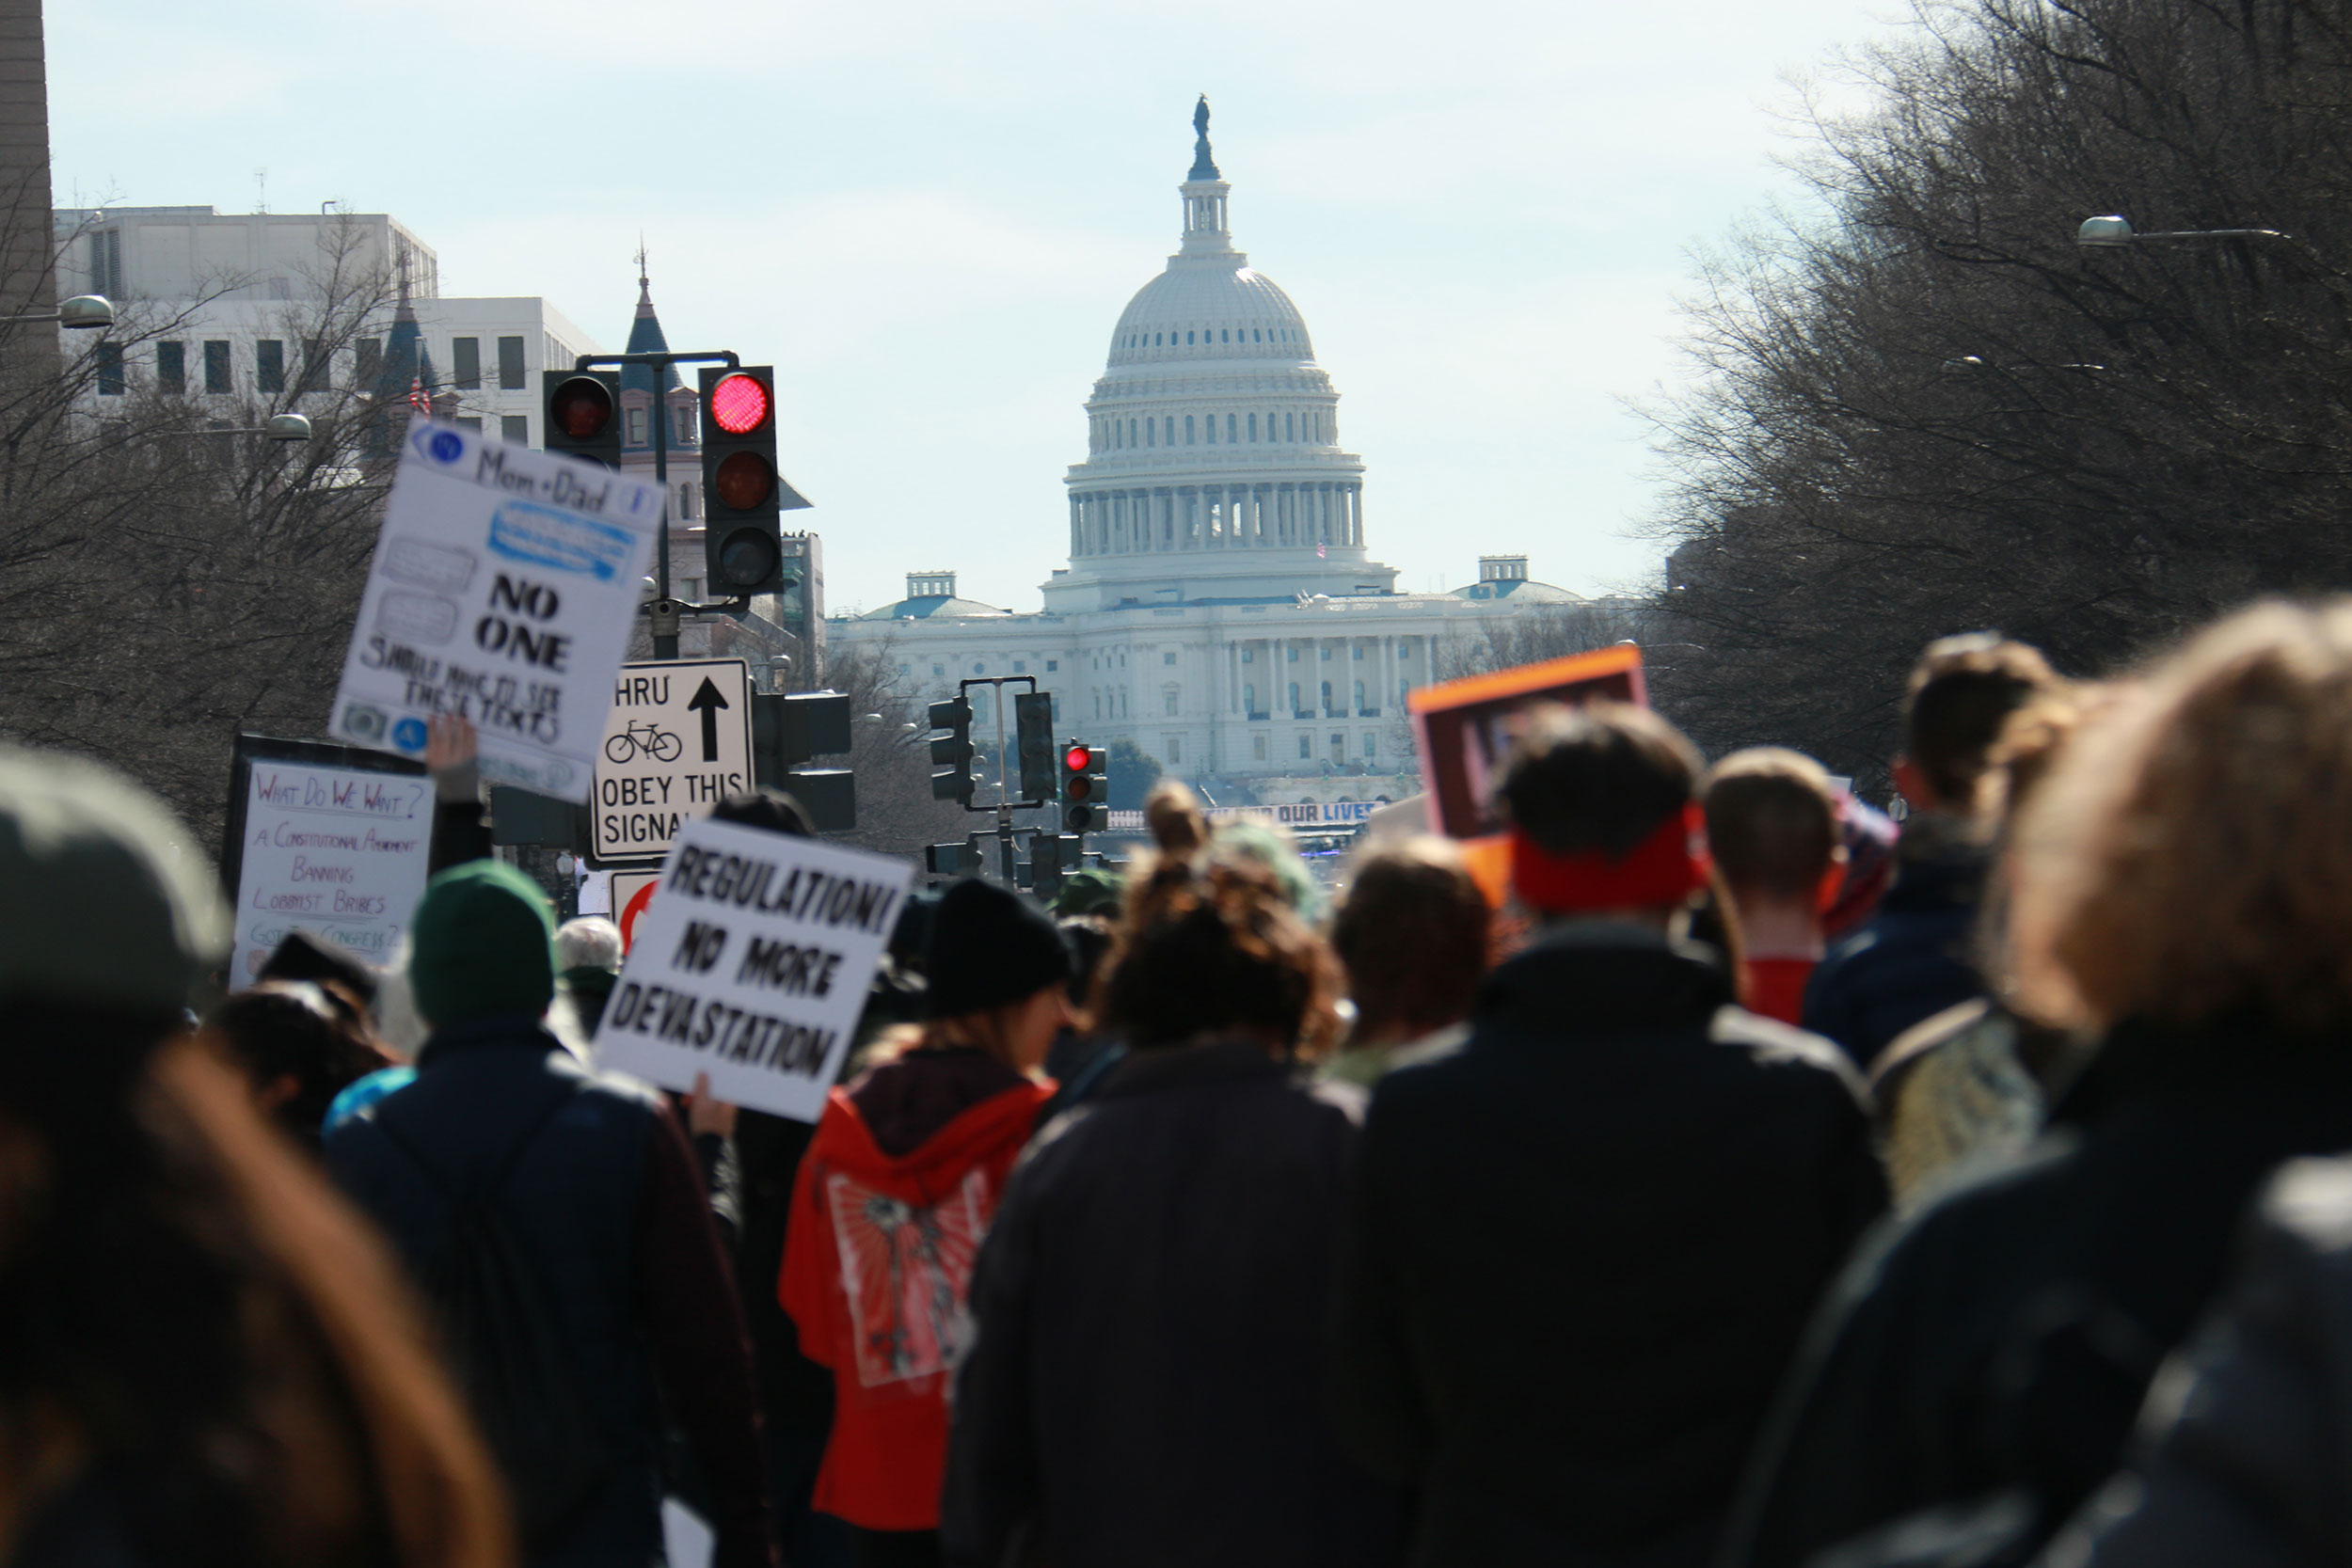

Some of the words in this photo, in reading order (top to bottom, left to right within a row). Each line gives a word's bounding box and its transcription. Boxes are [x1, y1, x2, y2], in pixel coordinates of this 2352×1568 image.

[489, 573, 559, 621] NO
[475, 616, 571, 674] ONE
[615, 676, 670, 706] HRU
[603, 777, 673, 807] OBEY
[685, 773, 742, 803] THIS
[605, 813, 690, 844] SIGNA
[1279, 805, 1318, 822] OUR
[253, 830, 268, 847] A
[667, 843, 898, 937] REGULATION!
[671, 920, 728, 975] NO
[735, 937, 843, 1003] MORE
[610, 982, 837, 1084] DEVASTATION
